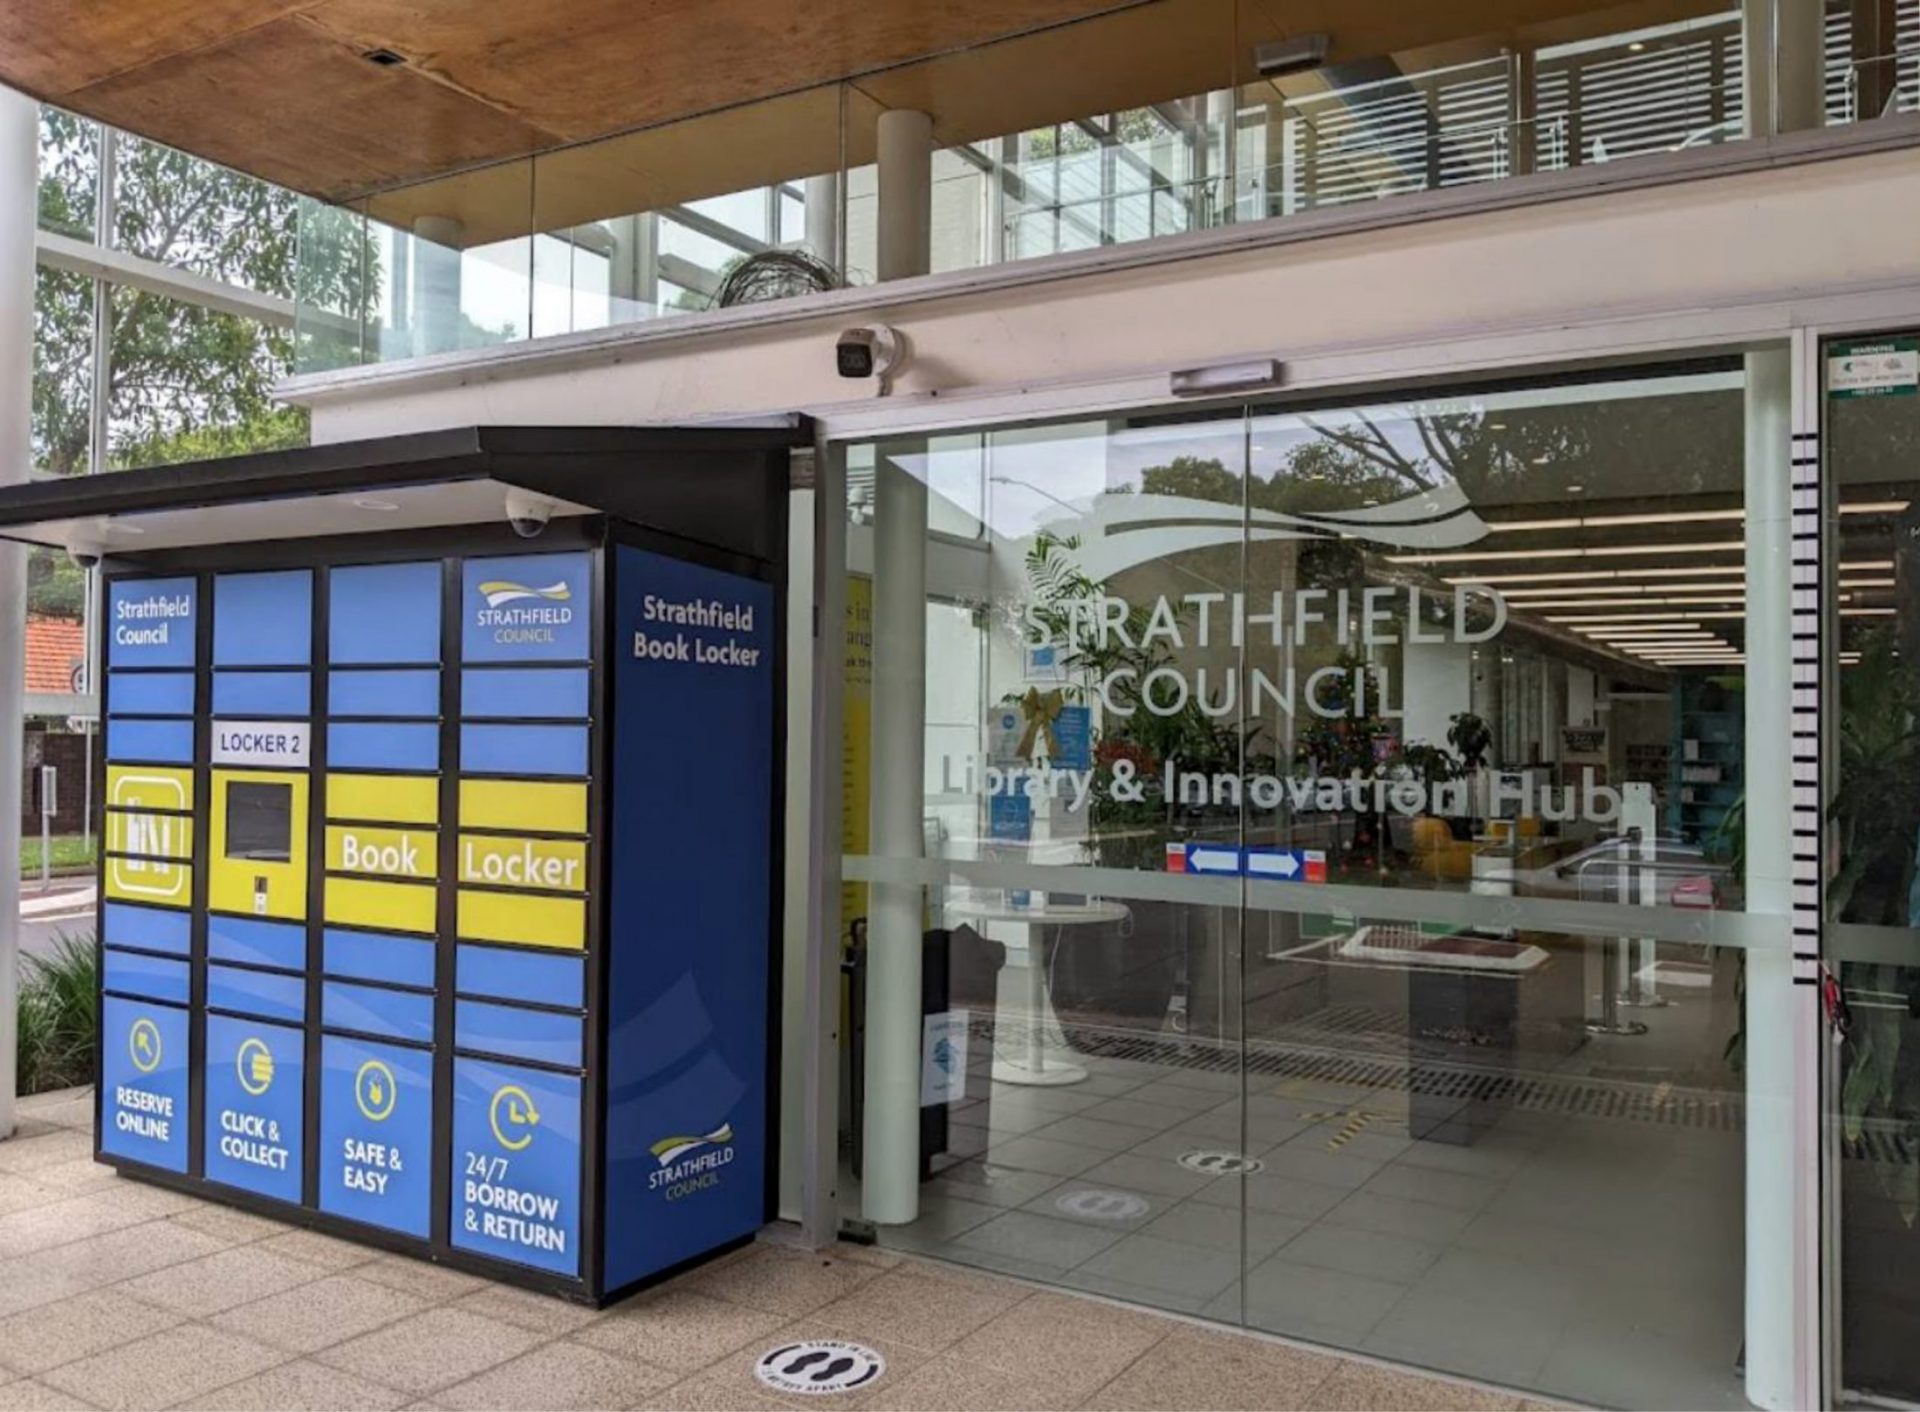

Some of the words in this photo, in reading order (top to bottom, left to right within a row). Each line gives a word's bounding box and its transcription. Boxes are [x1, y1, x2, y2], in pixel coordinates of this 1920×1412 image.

[116, 595, 190, 619] Strathfield
[477, 606, 572, 627] STRATHFIELD
[643, 594, 753, 631] Strathfield
[1025, 584, 1508, 649] STRATHFIELD
[116, 622, 168, 645] Council
[494, 627, 554, 644] COUNCIL
[634, 633, 689, 664] Book
[695, 637, 760, 667] Locker
[1102, 666, 1404, 718] COUNCIL
[220, 733, 286, 753] LOCKER
[291, 735, 300, 754] 2
[943, 755, 1093, 812] Library
[1110, 759, 1145, 802] &
[1166, 760, 1468, 817] Innovation
[1490, 766, 1622, 821] Hub
[343, 836, 417, 873] Book
[466, 842, 579, 885] Locker
[117, 1087, 172, 1117] RESERVE
[116, 1112, 170, 1142] ONLINE
[222, 1110, 265, 1138] CLICK
[268, 1121, 280, 1141] &
[221, 1136, 288, 1170] COLLECT
[344, 1139, 386, 1167] SAFE
[389, 1147, 402, 1171] &
[465, 1152, 507, 1183] 24/7
[649, 1147, 734, 1190] STRATHFIELD
[344, 1167, 387, 1195] EASY
[665, 1172, 719, 1201] COUNCIL
[465, 1180, 558, 1222] BORROW
[465, 1208, 480, 1232] &
[483, 1214, 564, 1254] RETURN
